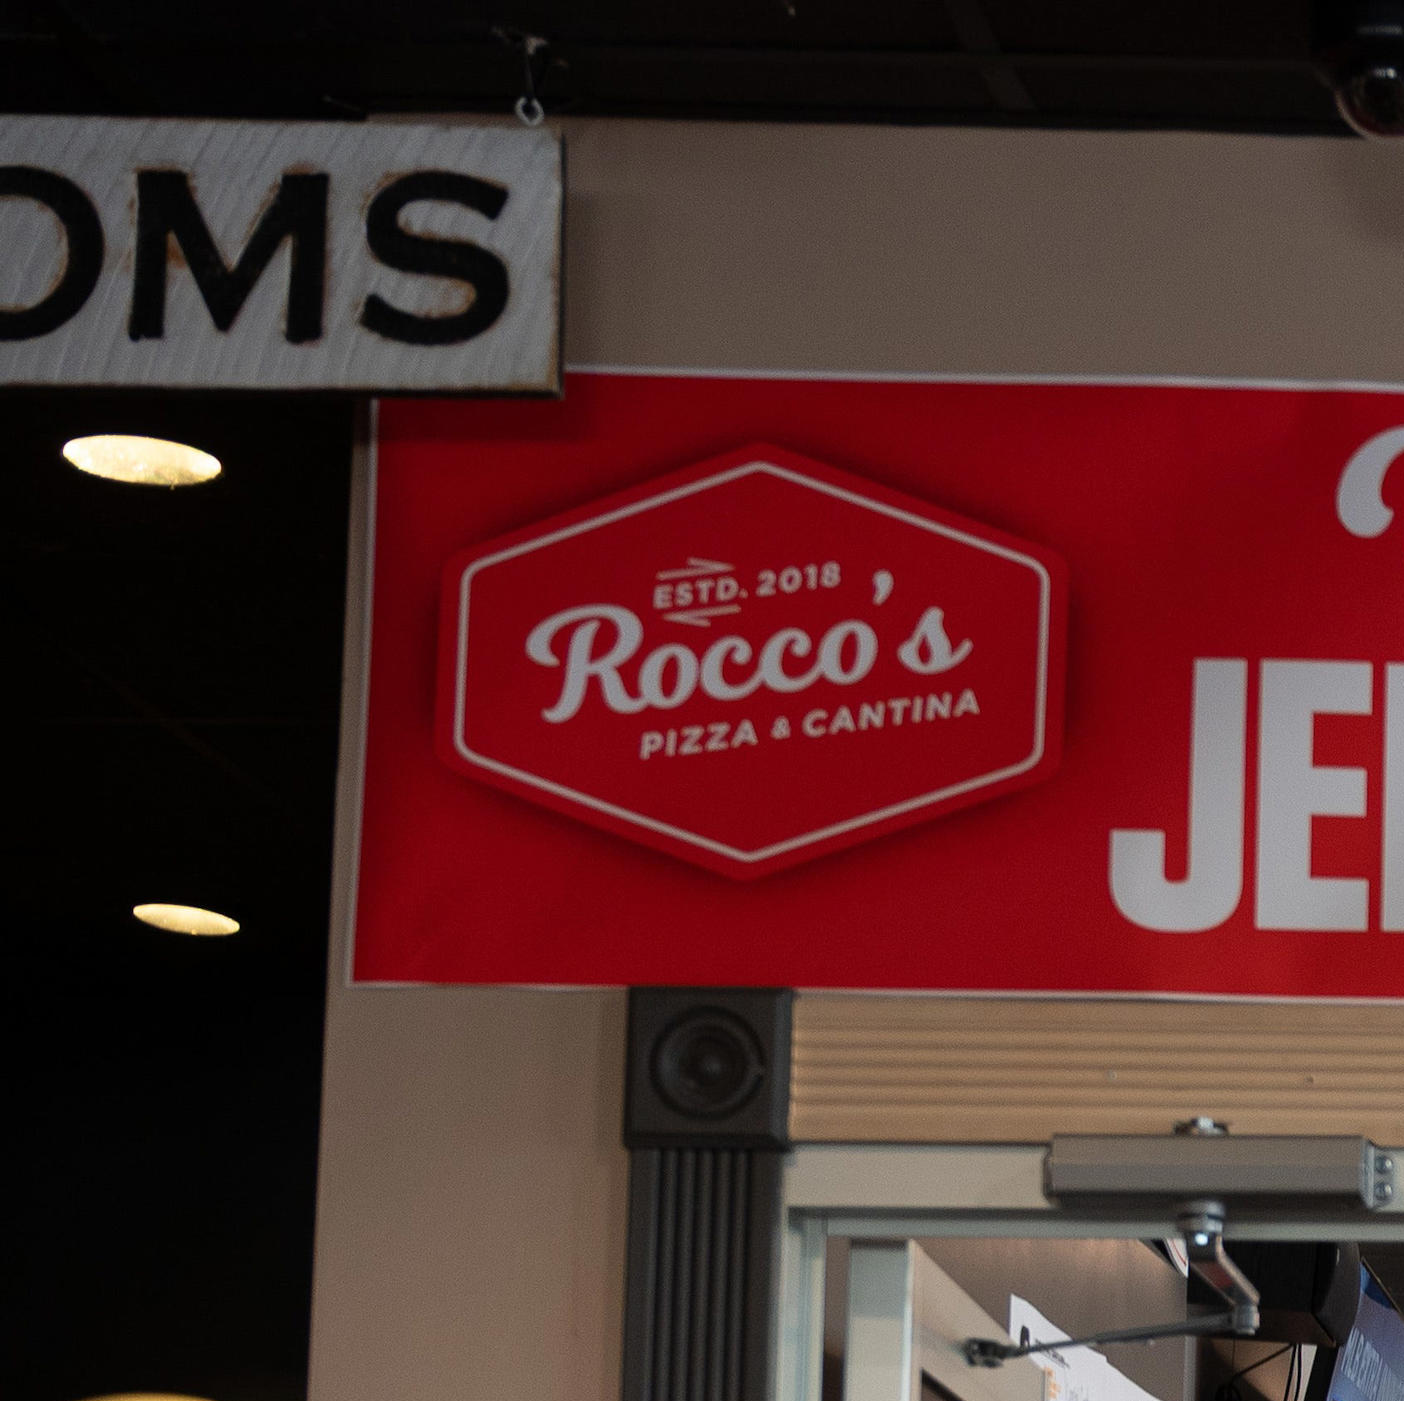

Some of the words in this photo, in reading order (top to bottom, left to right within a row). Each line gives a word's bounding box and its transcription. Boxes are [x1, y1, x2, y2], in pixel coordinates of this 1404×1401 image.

[653, 574, 749, 609] ESTD.
[755, 561, 841, 597] 2018
[525, 569, 973, 724] Rocco's
[639, 718, 758, 760] PIZZA
[770, 716, 791, 740] &
[802, 688, 980, 738] CANTINA
